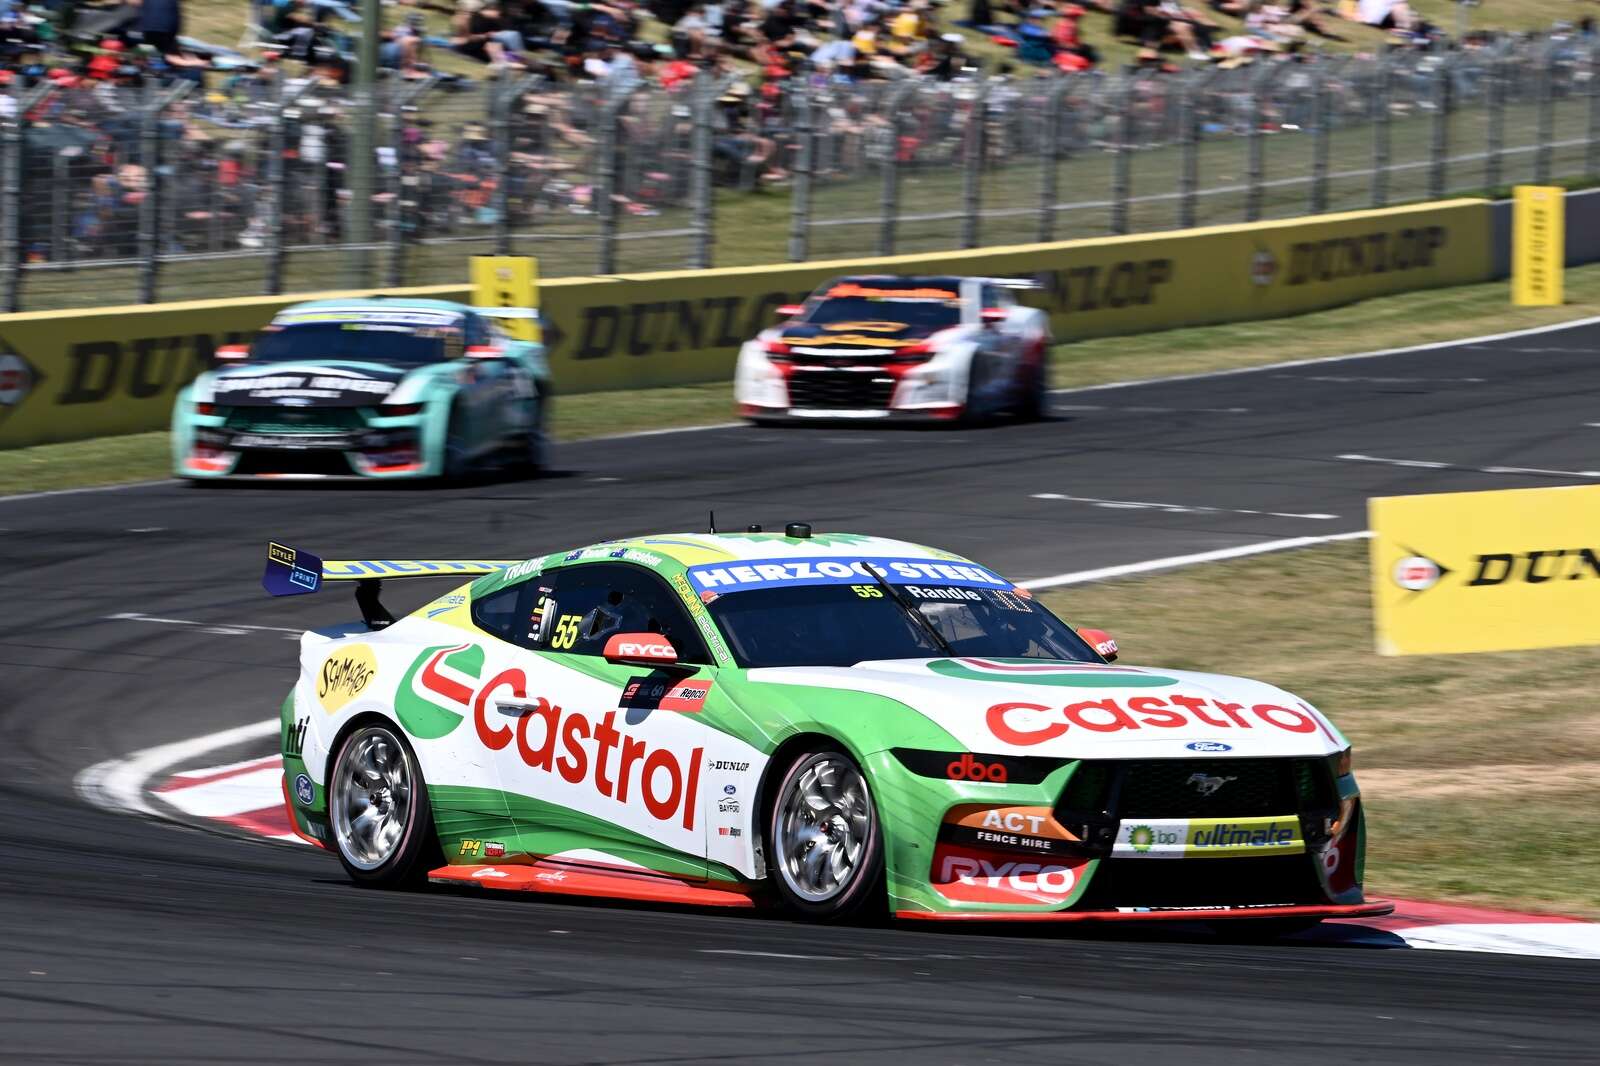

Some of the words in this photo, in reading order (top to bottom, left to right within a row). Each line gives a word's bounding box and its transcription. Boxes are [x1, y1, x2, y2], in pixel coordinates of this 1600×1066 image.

[272, 548, 293, 561] STYLE
[294, 571, 314, 584] PRINT
[693, 561, 888, 588] HERZOG
[889, 561, 1006, 586] STEEL
[850, 585, 884, 598] 55
[904, 585, 982, 601] Randle
[552, 614, 583, 649] 55
[680, 687, 706, 700] Repco
[986, 695, 1339, 746] Castrol
[474, 668, 704, 831] Castrol
[715, 760, 750, 772] DUNLOP
[946, 754, 1008, 783] dba
[982, 810, 1046, 833] ACT
[977, 831, 1017, 845] FENCE
[1021, 837, 1052, 849] HIRE
[1157, 829, 1178, 845] bp
[1193, 822, 1294, 848] ultimate
[940, 855, 1075, 894] RYCO
